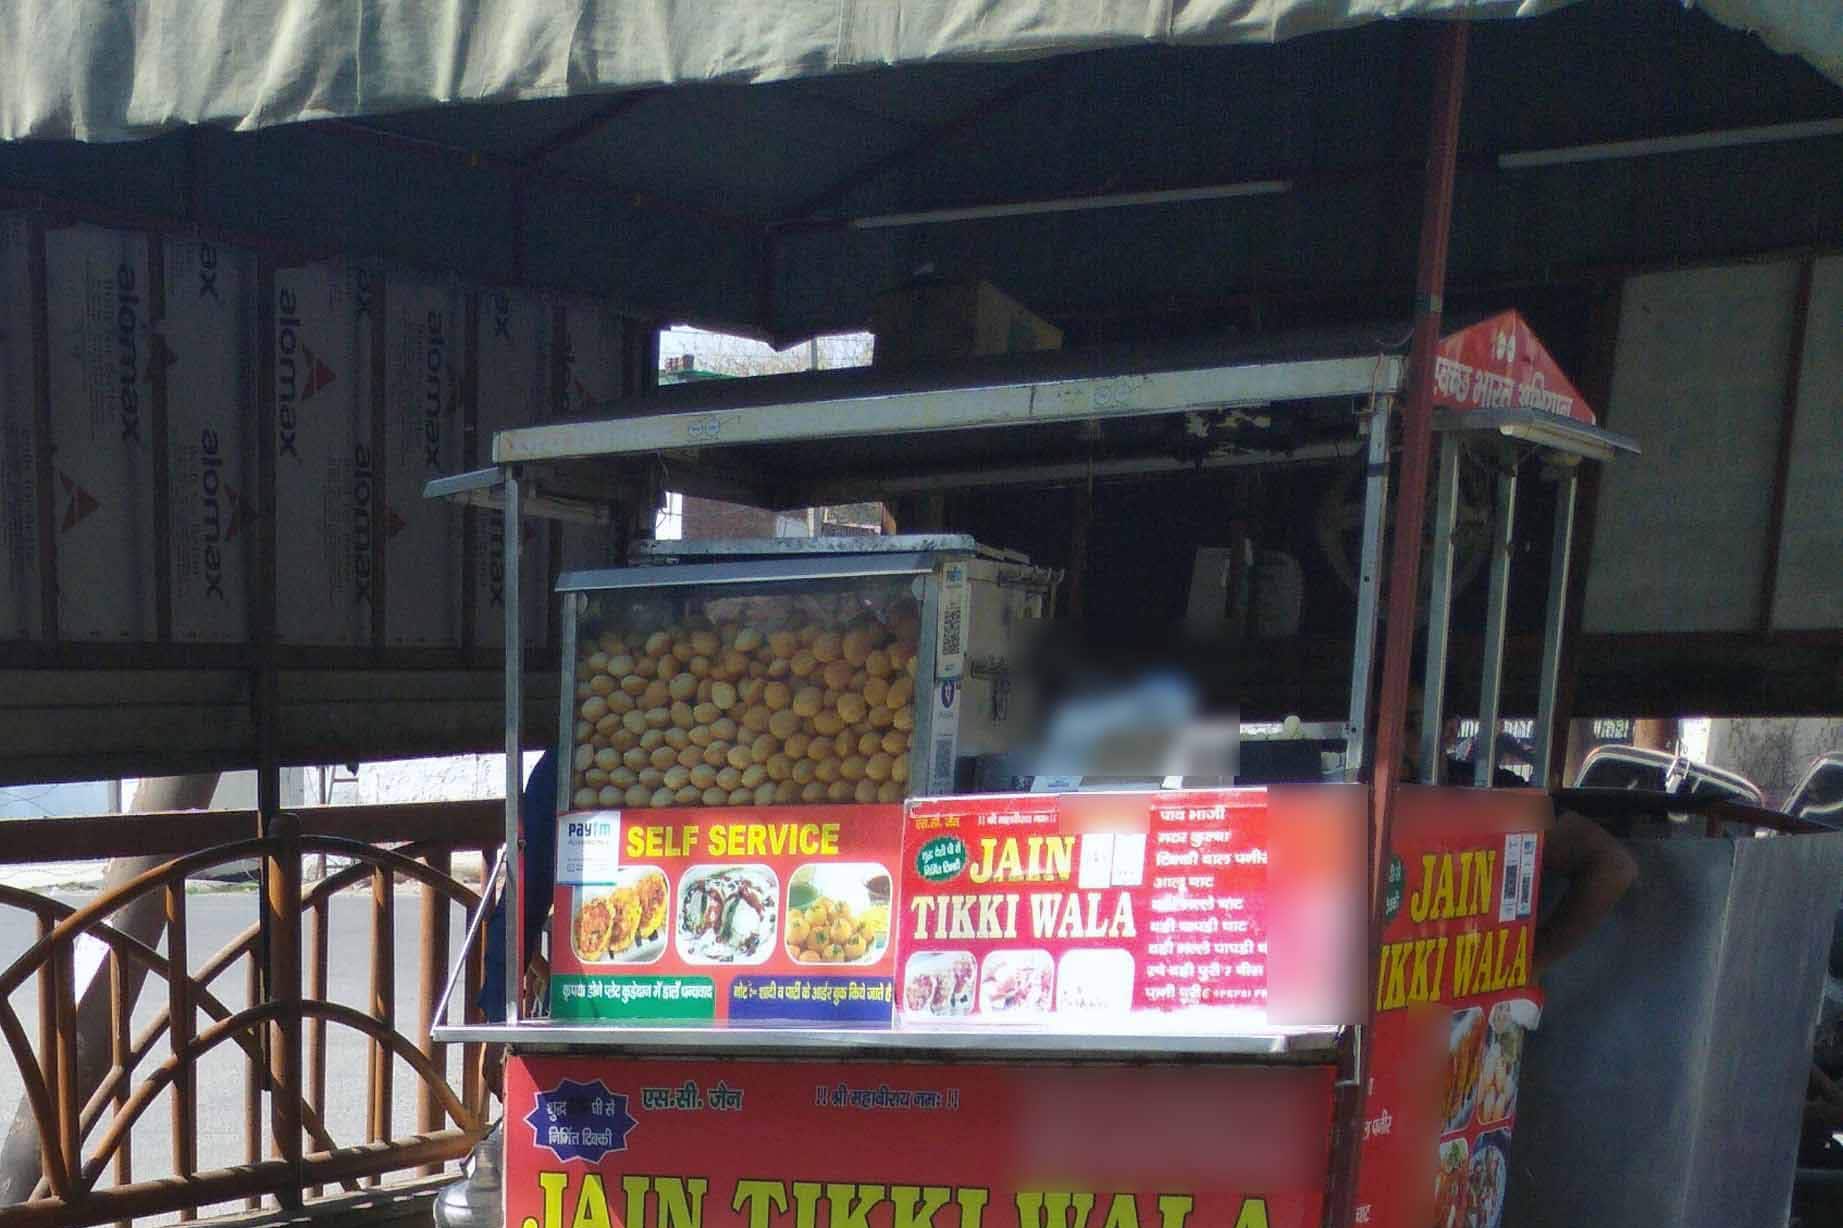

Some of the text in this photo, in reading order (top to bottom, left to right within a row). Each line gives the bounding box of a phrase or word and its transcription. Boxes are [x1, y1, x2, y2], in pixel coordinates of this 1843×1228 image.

[279, 288, 299, 458] alomax
[200, 431, 222, 600] alomax
[627, 823, 840, 858] SELF SERVICE
[970, 835, 1075, 884] JAIN
[910, 891, 1137, 940] TIKKI WALA
[1410, 850, 1496, 923] JAIN
[1376, 925, 1529, 1012] IKKI WALA
